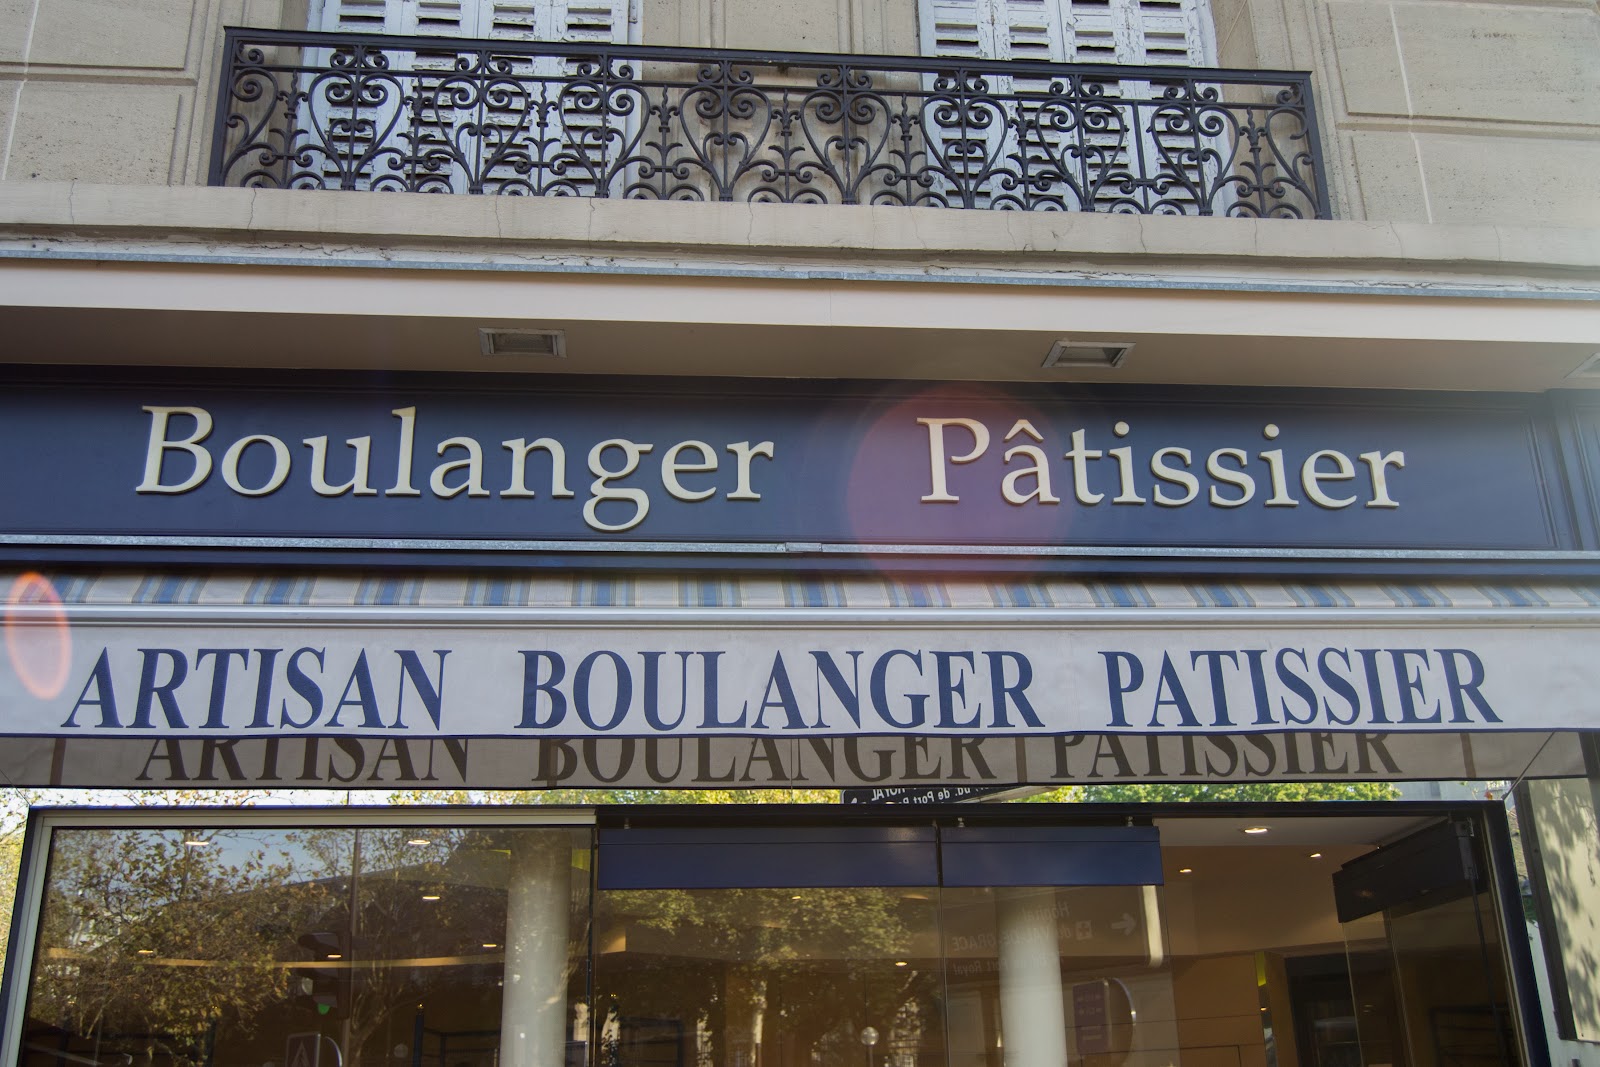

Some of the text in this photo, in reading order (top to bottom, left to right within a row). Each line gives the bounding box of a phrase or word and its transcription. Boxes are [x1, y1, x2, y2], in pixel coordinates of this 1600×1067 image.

[136, 405, 1405, 532] Boulanger Pâtissier
[61, 646, 1503, 732] ARTISAN BOULANGER PATISSIER
[531, 737, 998, 783] BOULANGER
